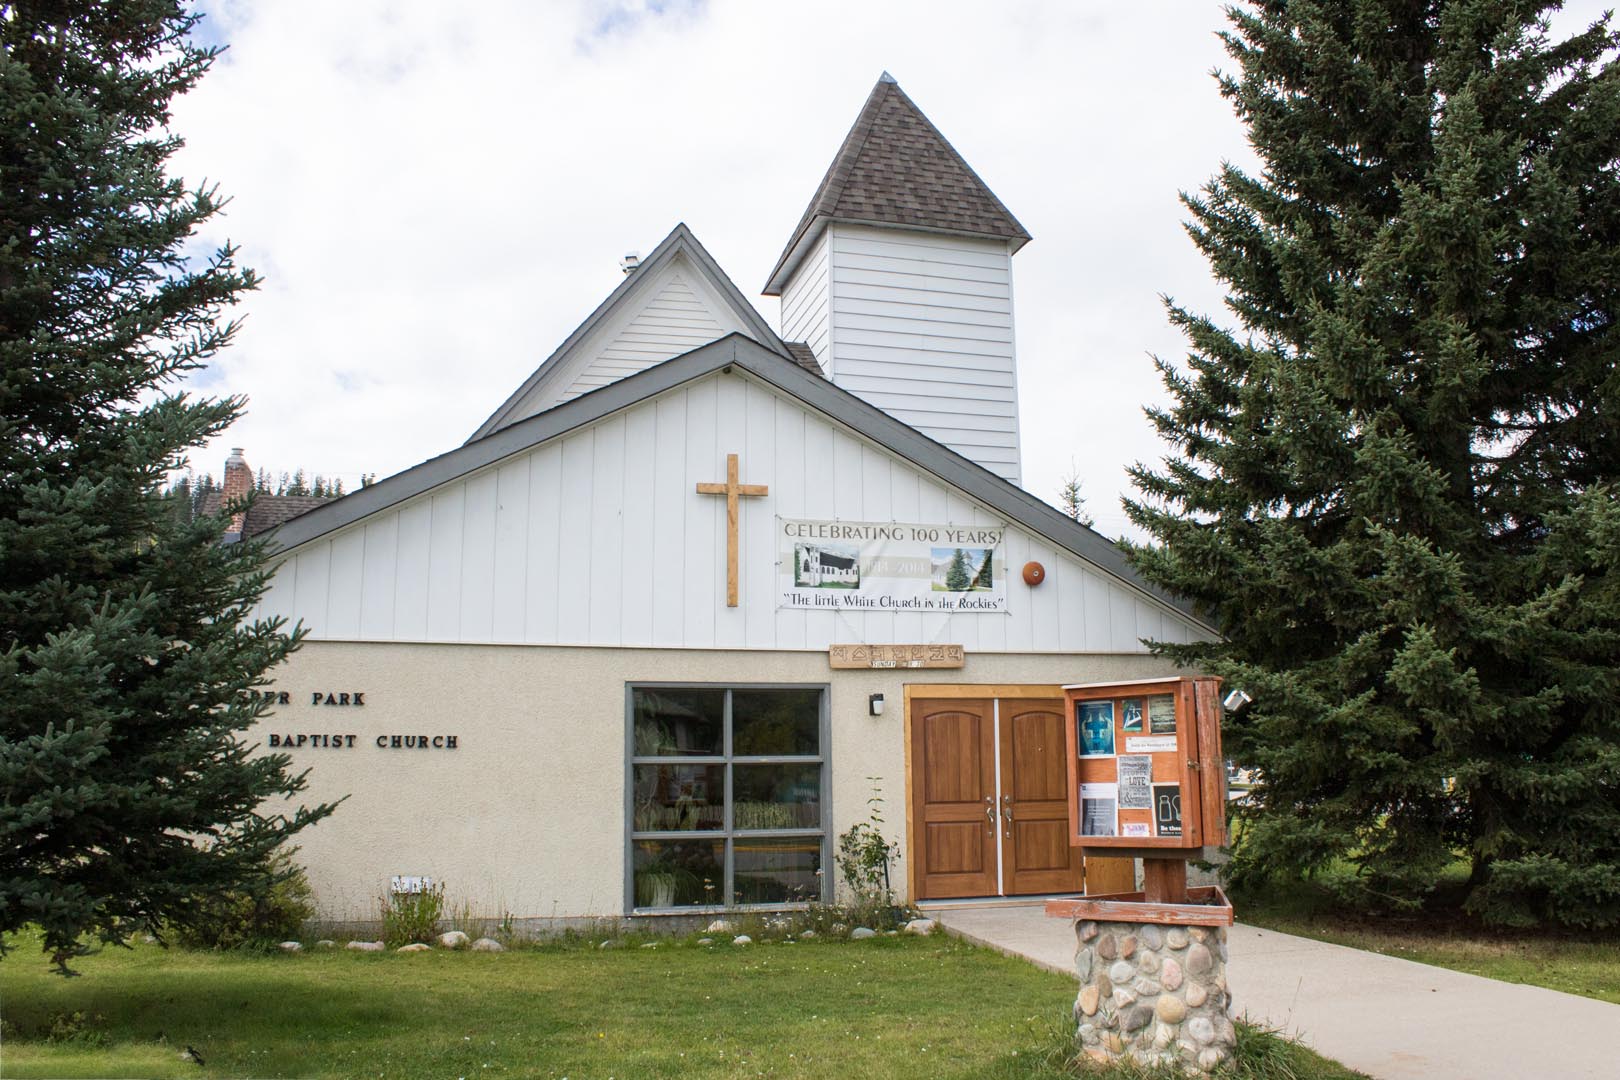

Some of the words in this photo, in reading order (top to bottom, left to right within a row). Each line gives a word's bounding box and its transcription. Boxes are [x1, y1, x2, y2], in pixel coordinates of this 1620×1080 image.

[784, 523, 904, 541] CELEBRATING
[911, 528, 939, 543] 100
[946, 530, 1002, 544] YEARS!
[843, 595, 876, 608] White
[880, 595, 920, 608] Church
[924, 597, 934, 608] in
[312, 692, 365, 706] PARK
[269, 734, 357, 748] BAPTIST
[376, 735, 458, 749] CHURCH
[1128, 776, 1146, 786] LOVE
